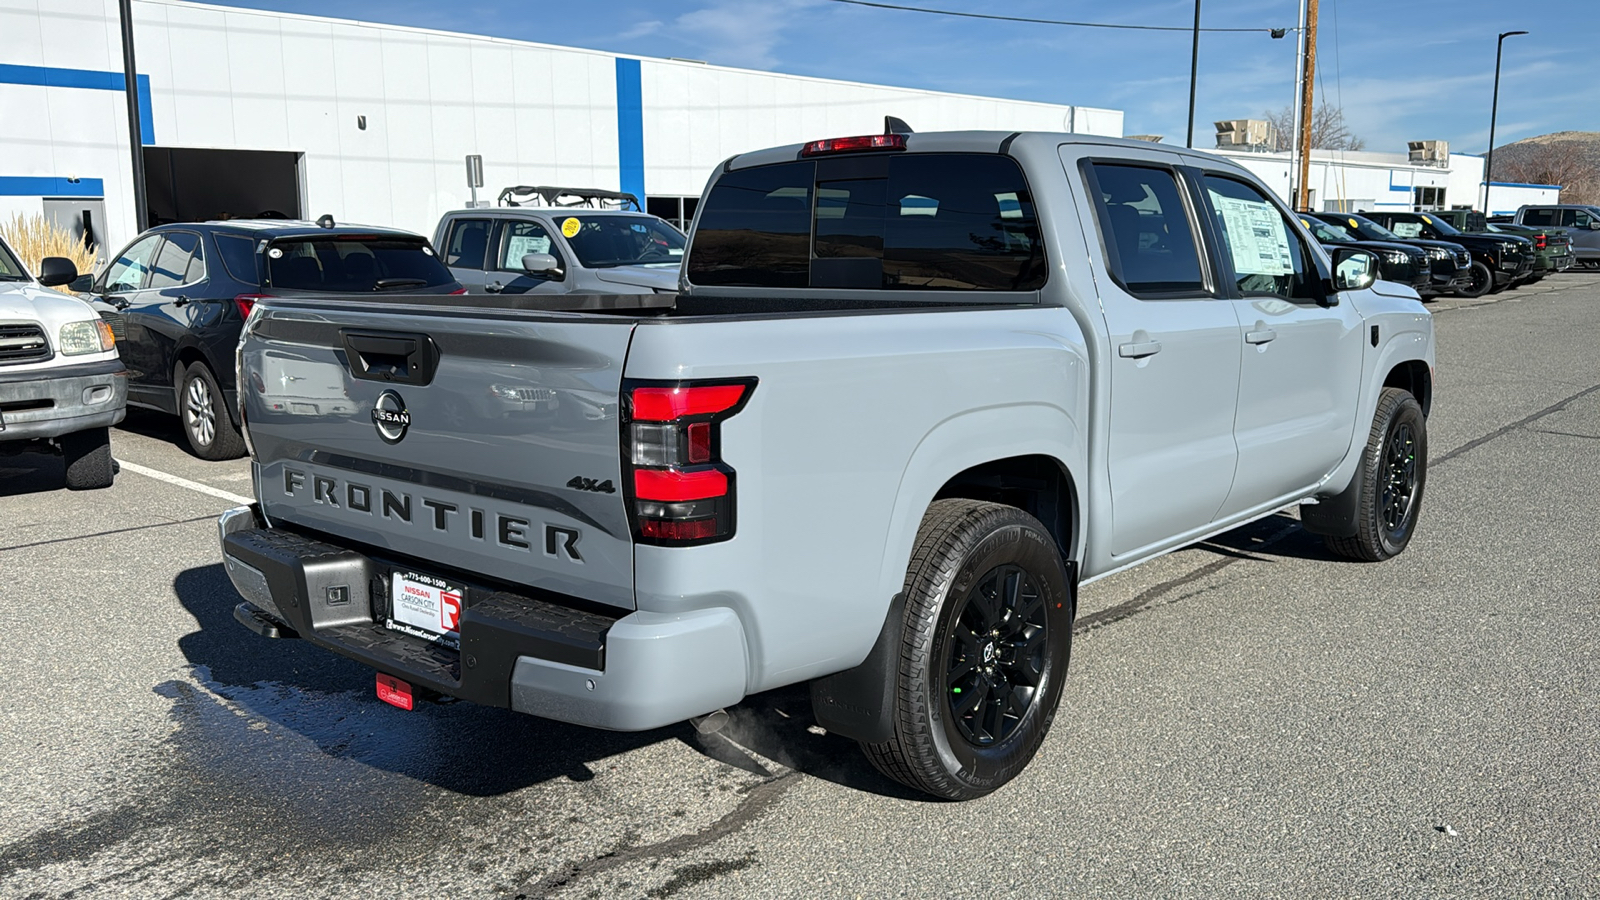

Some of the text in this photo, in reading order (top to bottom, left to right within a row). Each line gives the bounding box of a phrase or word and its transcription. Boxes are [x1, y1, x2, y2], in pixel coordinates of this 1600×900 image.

[372, 410, 409, 424] NISSAN
[283, 468, 586, 563] FRONTIER
[408, 571, 447, 588] 775-600-1500
[404, 585, 431, 599] NISSAN
[401, 593, 435, 609] CARSON CITY
